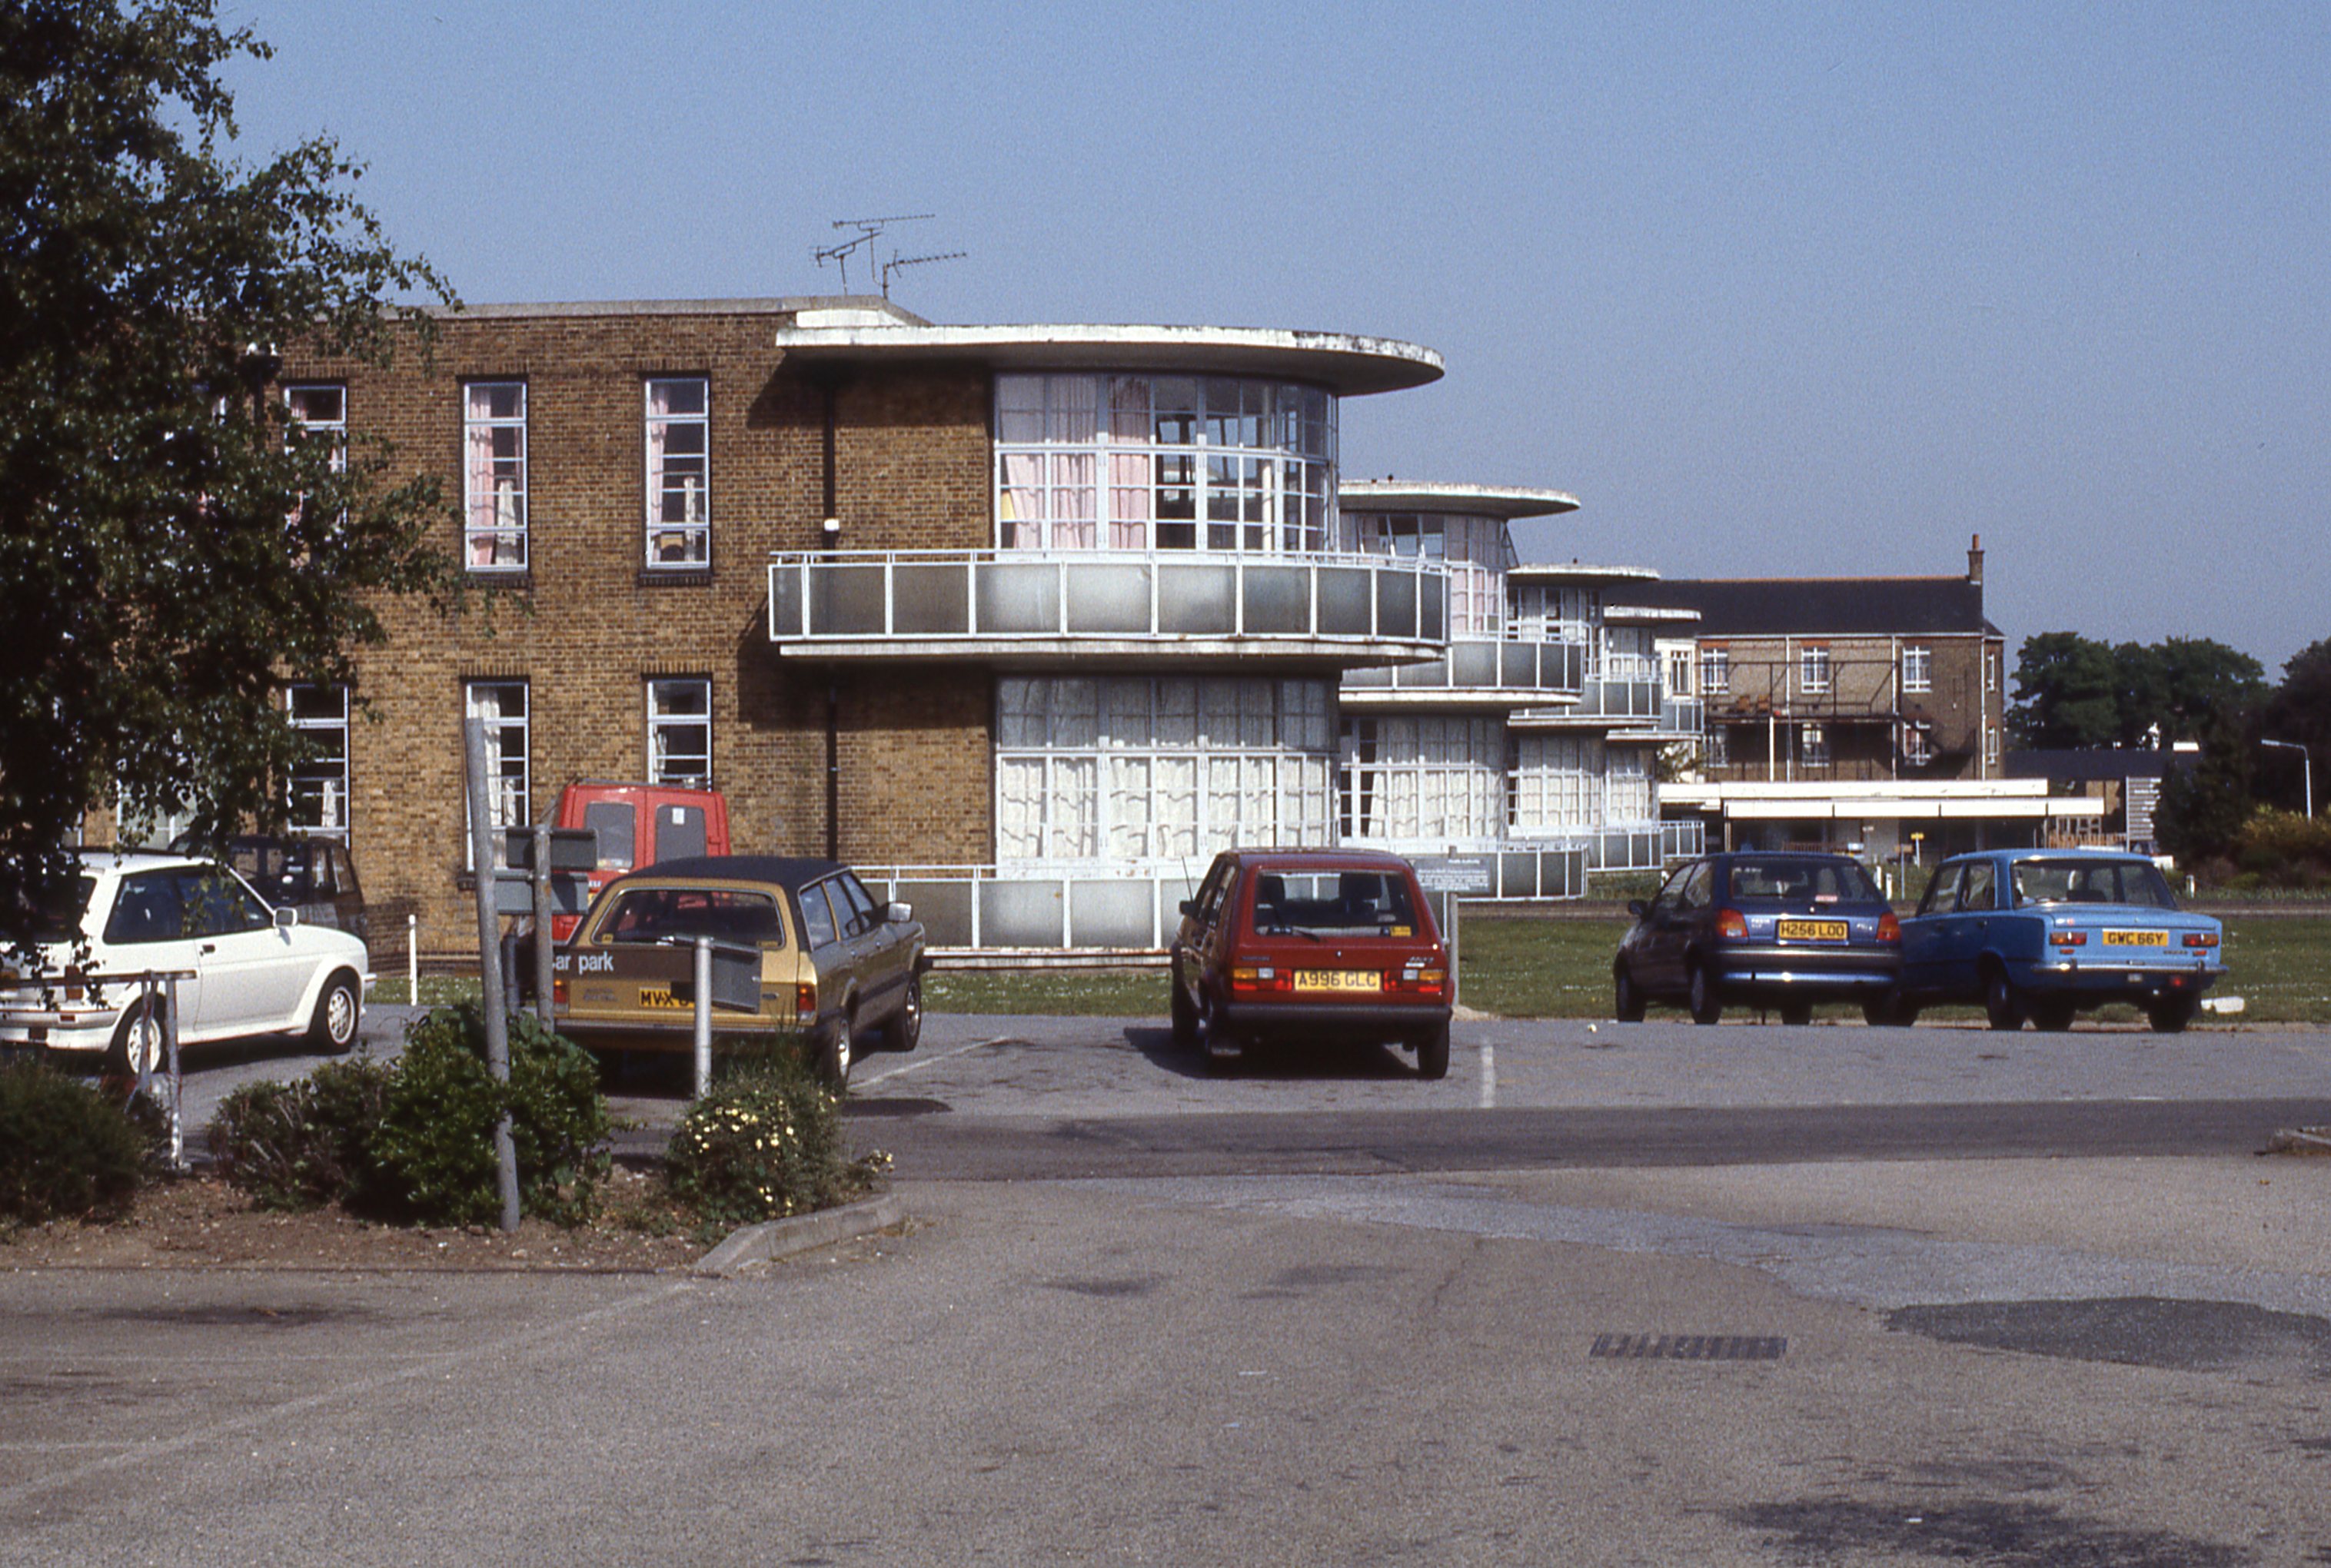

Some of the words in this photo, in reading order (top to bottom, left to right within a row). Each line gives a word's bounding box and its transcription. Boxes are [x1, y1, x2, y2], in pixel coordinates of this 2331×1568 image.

[1781, 924, 1816, 937] H256
[2107, 932, 2133, 945] GWC
[2137, 932, 2163, 945] 66Y
[552, 955, 571, 971] ar
[578, 950, 614, 975] park
[1299, 971, 1341, 987] A996
[640, 990, 674, 1006] MVX
